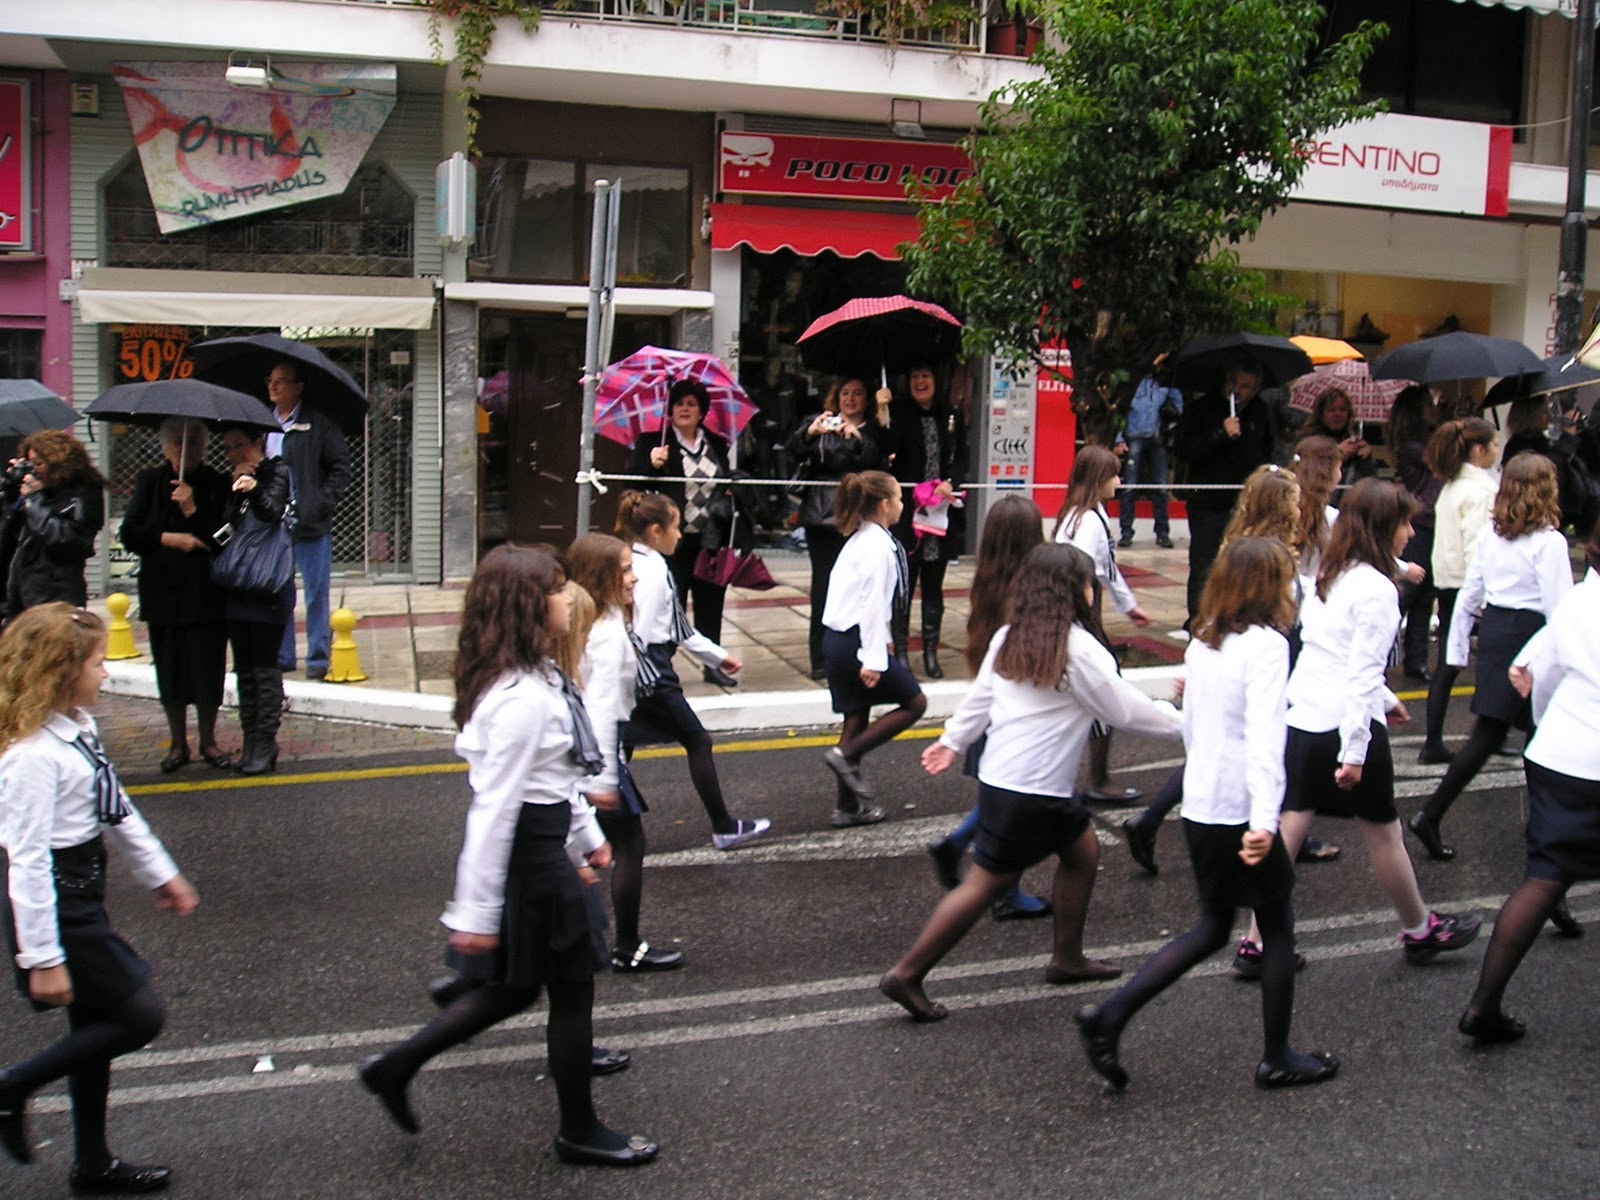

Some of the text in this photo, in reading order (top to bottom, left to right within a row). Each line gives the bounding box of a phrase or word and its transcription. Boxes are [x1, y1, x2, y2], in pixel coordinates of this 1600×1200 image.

[784, 158, 976, 187] POCO LOC
[1381, 178, 1439, 192] υποδήματα
[120, 339, 193, 382] 50%
